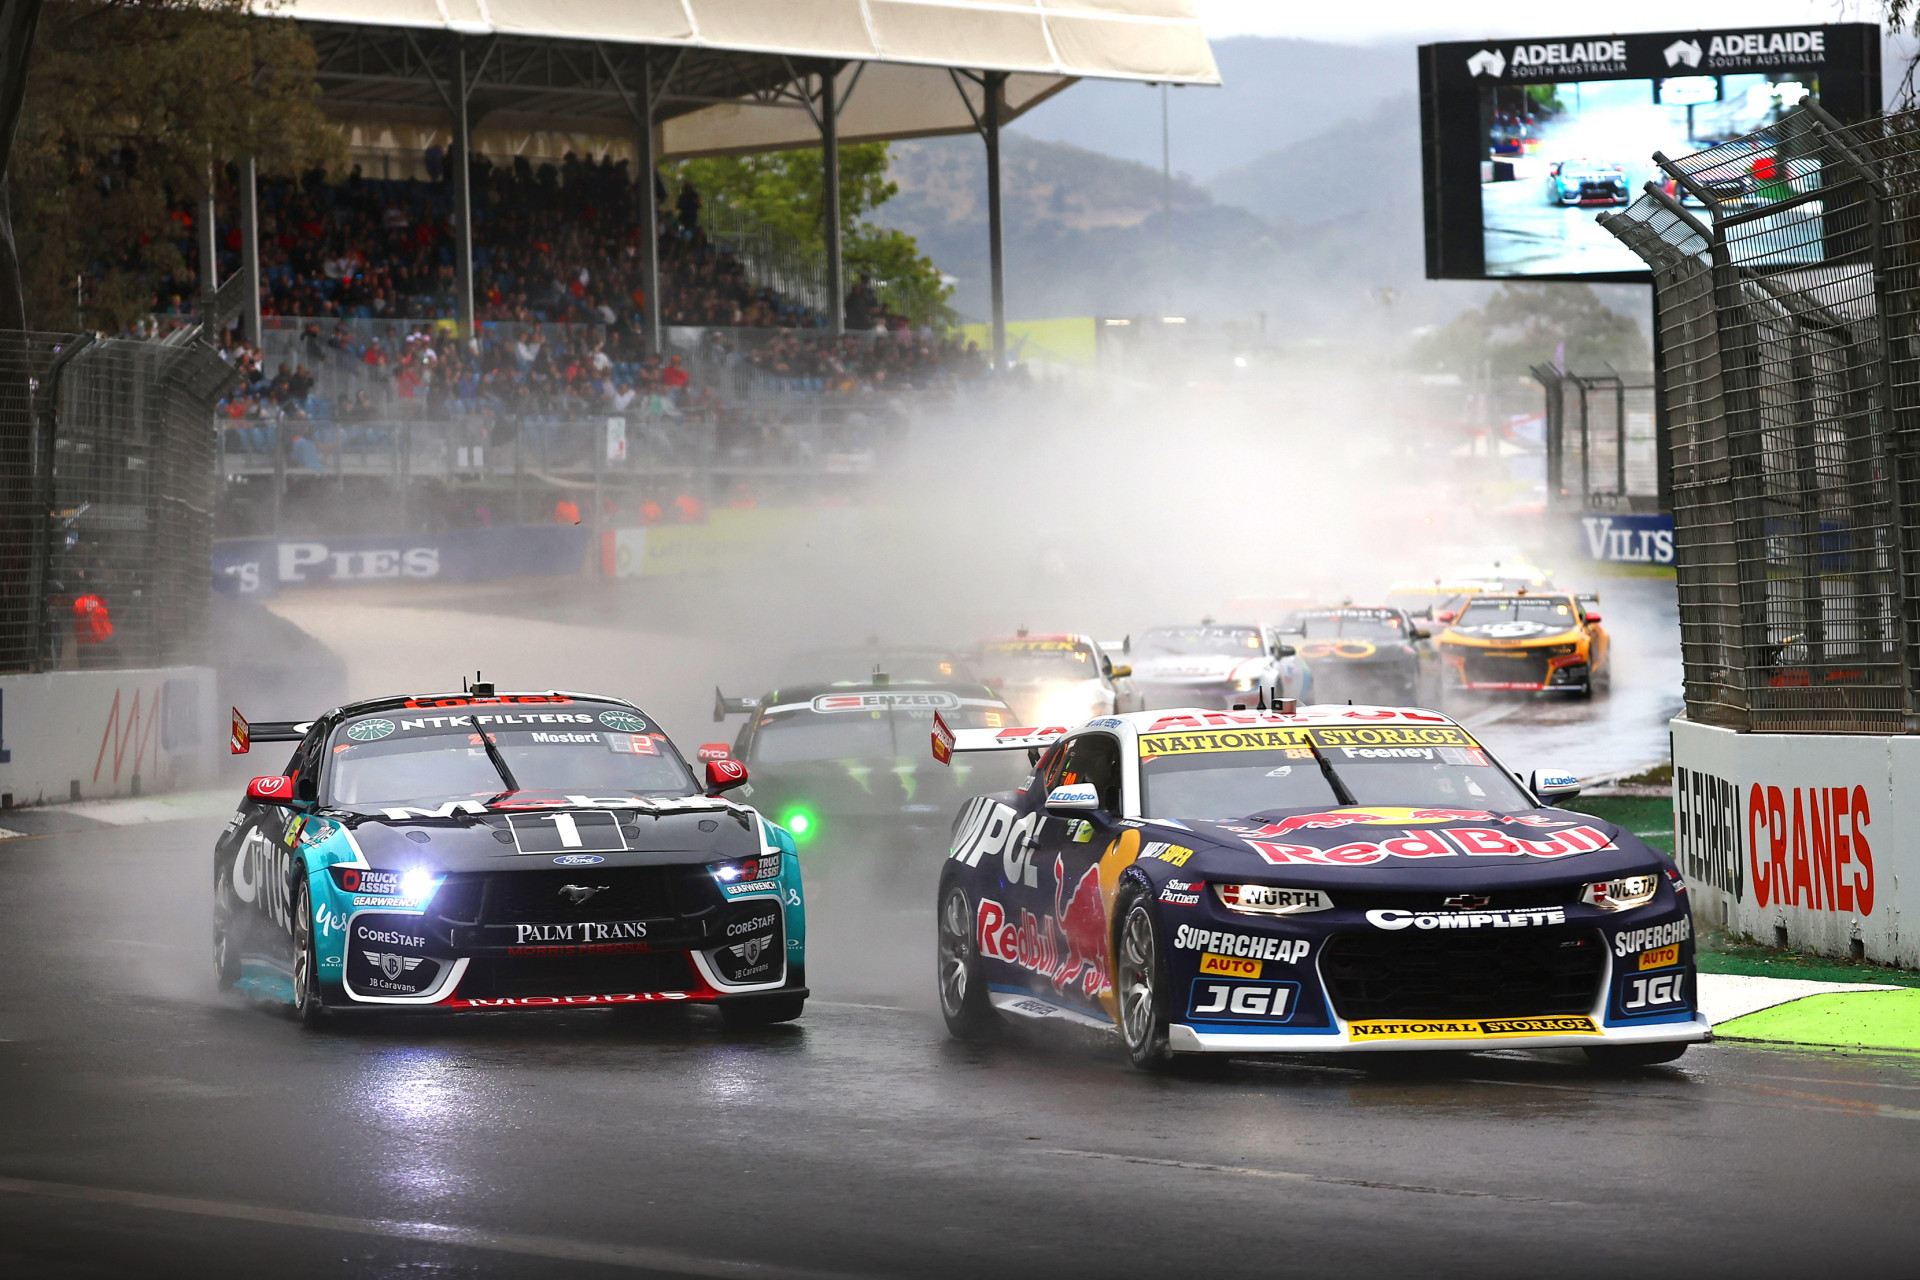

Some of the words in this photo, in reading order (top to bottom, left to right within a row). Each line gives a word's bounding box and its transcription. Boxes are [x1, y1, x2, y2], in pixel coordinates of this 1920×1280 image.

[1709, 32, 1826, 56] ADELAIDE
[1512, 41, 1627, 66] ADELAIDE
[1709, 56, 1750, 69] SOUTH
[1752, 52, 1826, 65] AUSTRALIA
[1512, 66, 1553, 78] SOUTH
[1554, 61, 1627, 74] AUSTRALIA
[277, 543, 440, 582] PIES
[863, 695, 946, 706] ENZED
[354, 724, 386, 732] NTK
[401, 715, 472, 730] NTK
[477, 713, 594, 725] FILTERS
[985, 712, 1002, 727] 3
[532, 732, 599, 743] Mostert
[631, 734, 654, 755] 2
[1143, 731, 1306, 753] NATIONAL
[1323, 728, 1463, 745] STORAGE
[1285, 748, 1315, 760] 88
[1340, 747, 1434, 760] Feeney
[1049, 792, 1096, 801] ACDelco
[541, 813, 583, 848] 1
[1677, 765, 1744, 905] FLEURIEU
[1242, 829, 1459, 865] Red
[1441, 826, 1620, 857] Bull
[1748, 782, 1875, 917] CRANES
[563, 854, 595, 864] Ford
[361, 871, 398, 883] TRUCK
[1165, 879, 1191, 891] Shaw
[358, 881, 397, 894] ASSIST
[727, 881, 777, 895] GEARWRENCH
[353, 896, 419, 907] GEARWRENCH
[1158, 889, 1200, 904] Partners
[1366, 909, 1566, 931] COMPLETE
[515, 924, 573, 944] PALM
[578, 921, 647, 942] TRANS
[977, 898, 1030, 968] Red
[1027, 911, 1060, 978] Bull
[508, 945, 576, 956] MORRIS
[578, 942, 652, 954] PERSONAL
[1174, 924, 1310, 965] SUPERCHEAP
[1206, 958, 1256, 974] AUTO
[1643, 949, 1675, 966] AUTO
[734, 968, 742, 979] JB
[743, 962, 769, 977] Caravans
[370, 977, 379, 987] JB
[380, 979, 416, 993] Caravans
[1626, 974, 1684, 1009] JGI
[1195, 985, 1290, 1016] JGI
[1353, 1022, 1477, 1036] NATIONAL
[1489, 1017, 1592, 1032] STORAGE
